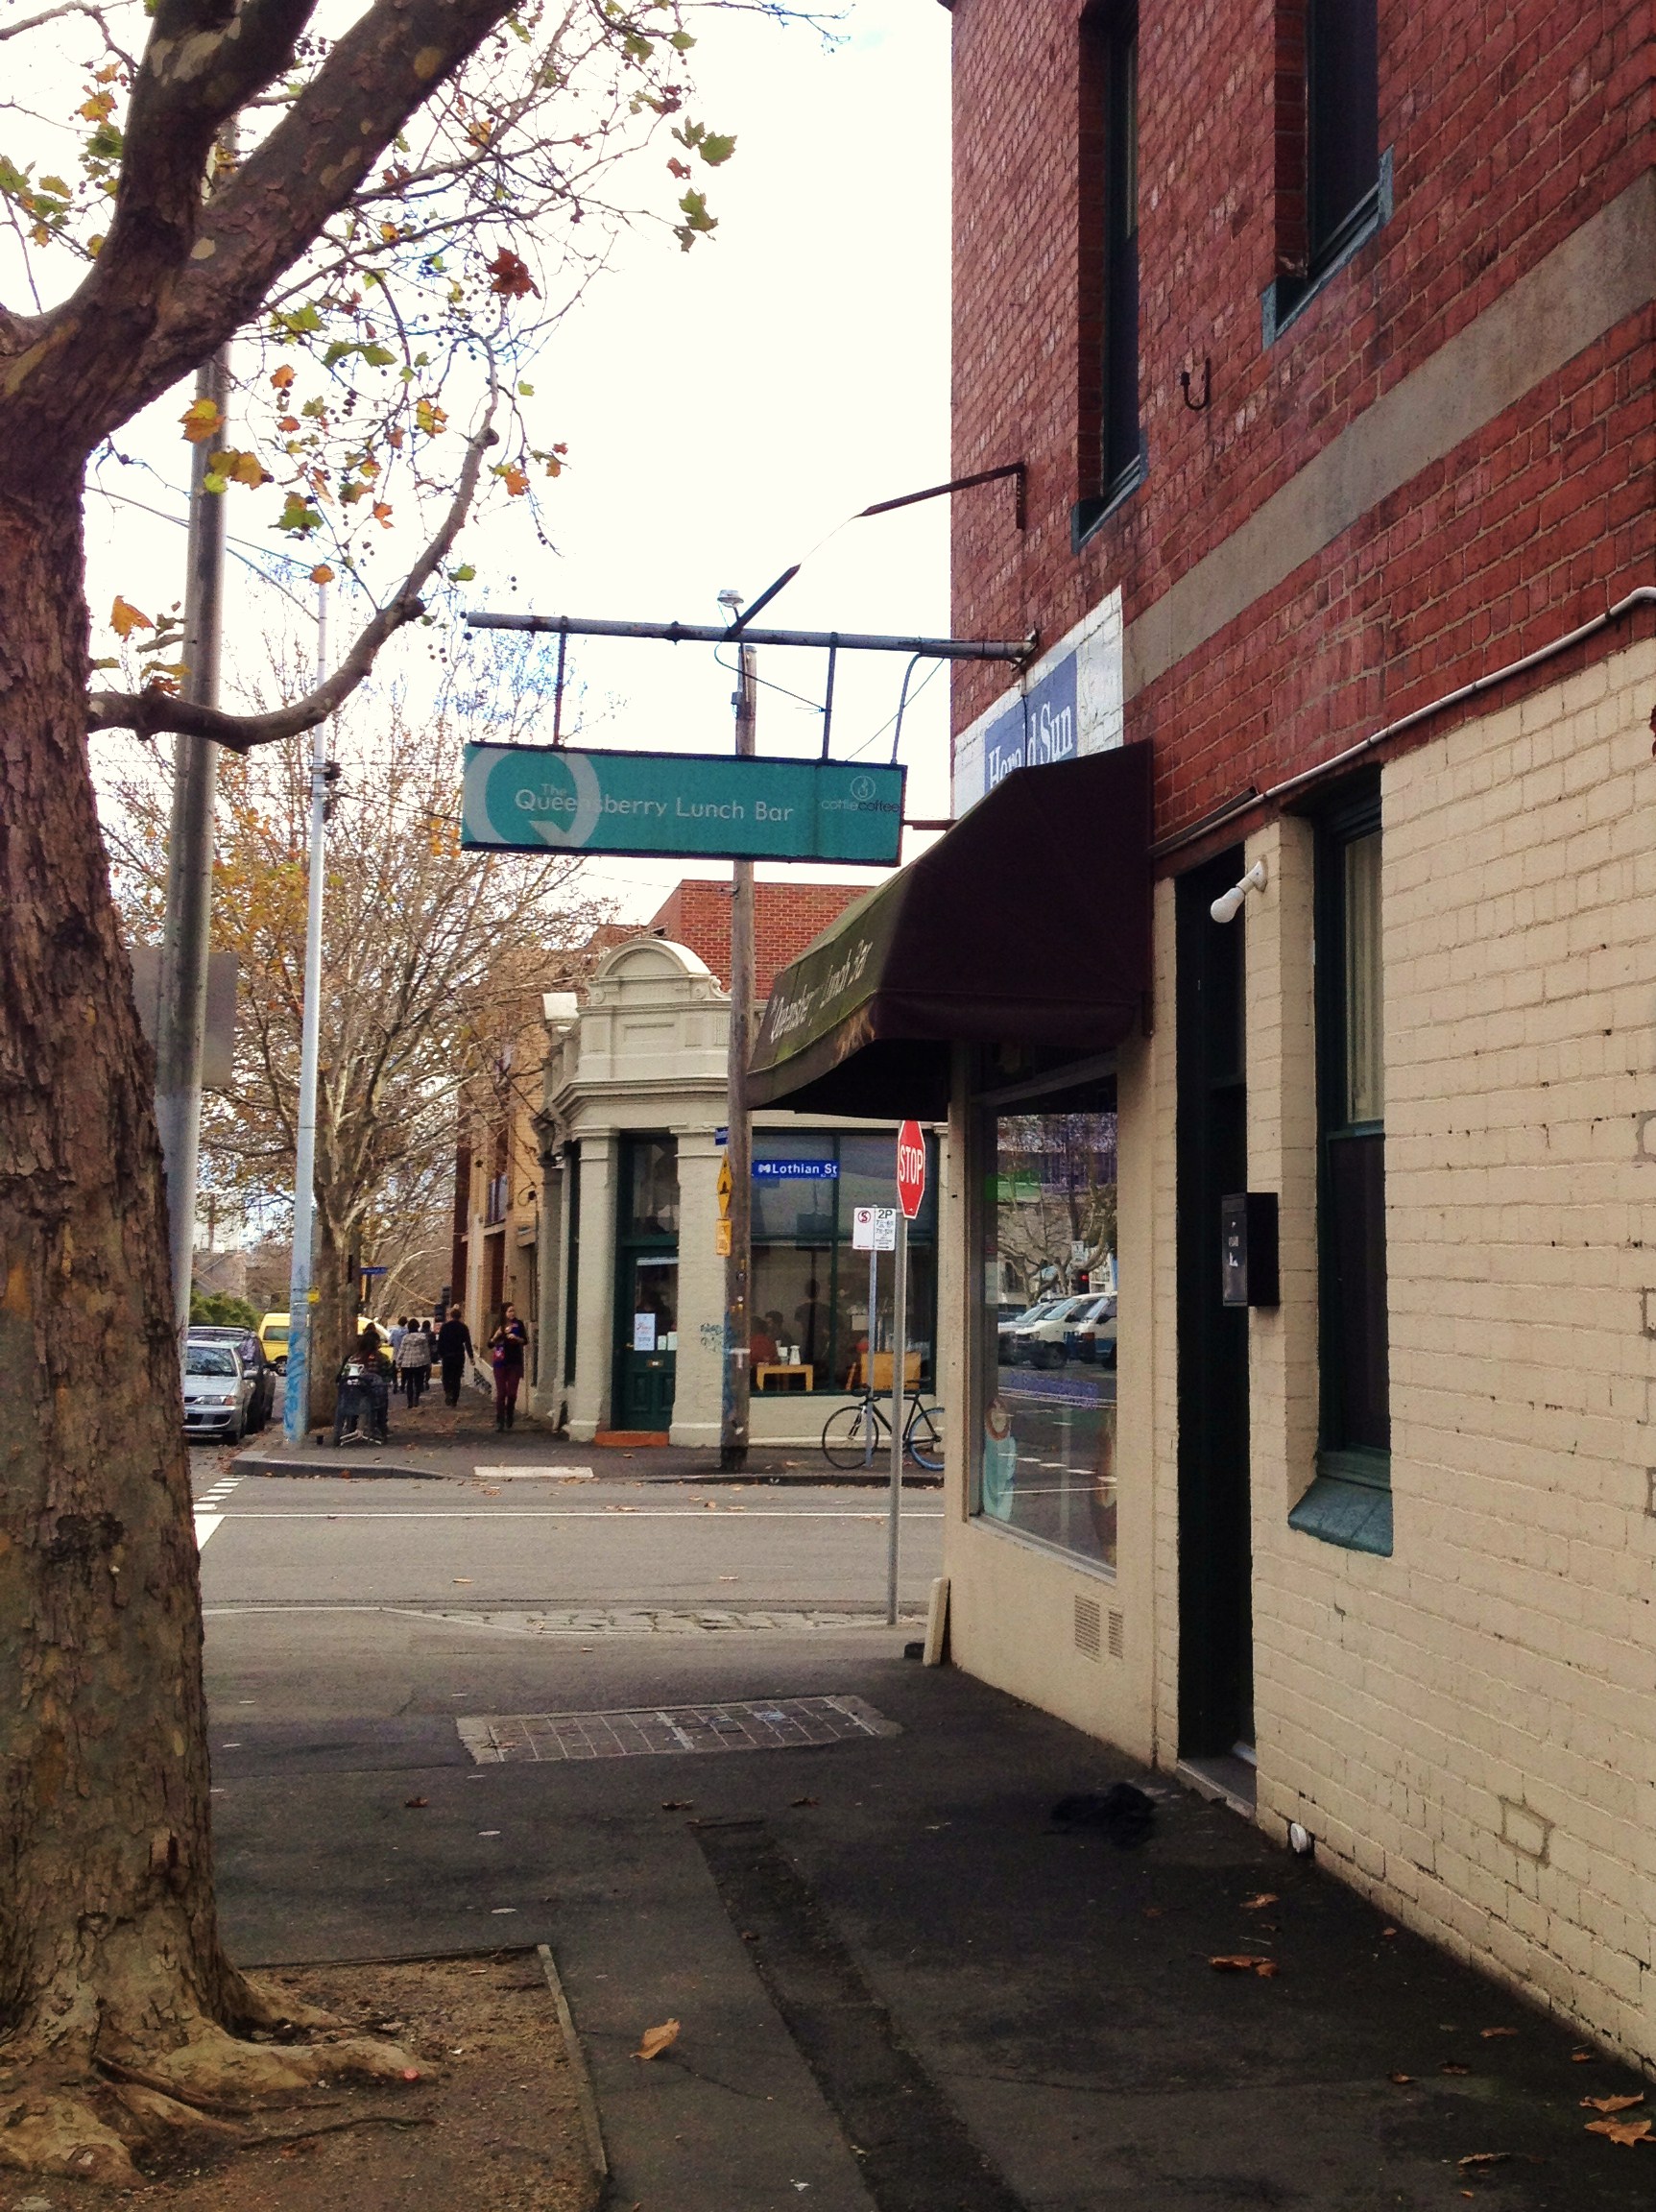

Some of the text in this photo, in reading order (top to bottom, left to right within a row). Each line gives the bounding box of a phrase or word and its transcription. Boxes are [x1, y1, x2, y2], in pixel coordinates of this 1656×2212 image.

[989, 701, 1072, 789] Herad Sun
[540, 782, 567, 797] The
[676, 797, 744, 820] Lunch
[756, 801, 794, 822] Bar
[772, 1163, 838, 1174] Lothian St
[900, 1143, 924, 1186] STOP
[877, 1209, 893, 1219] 2P
